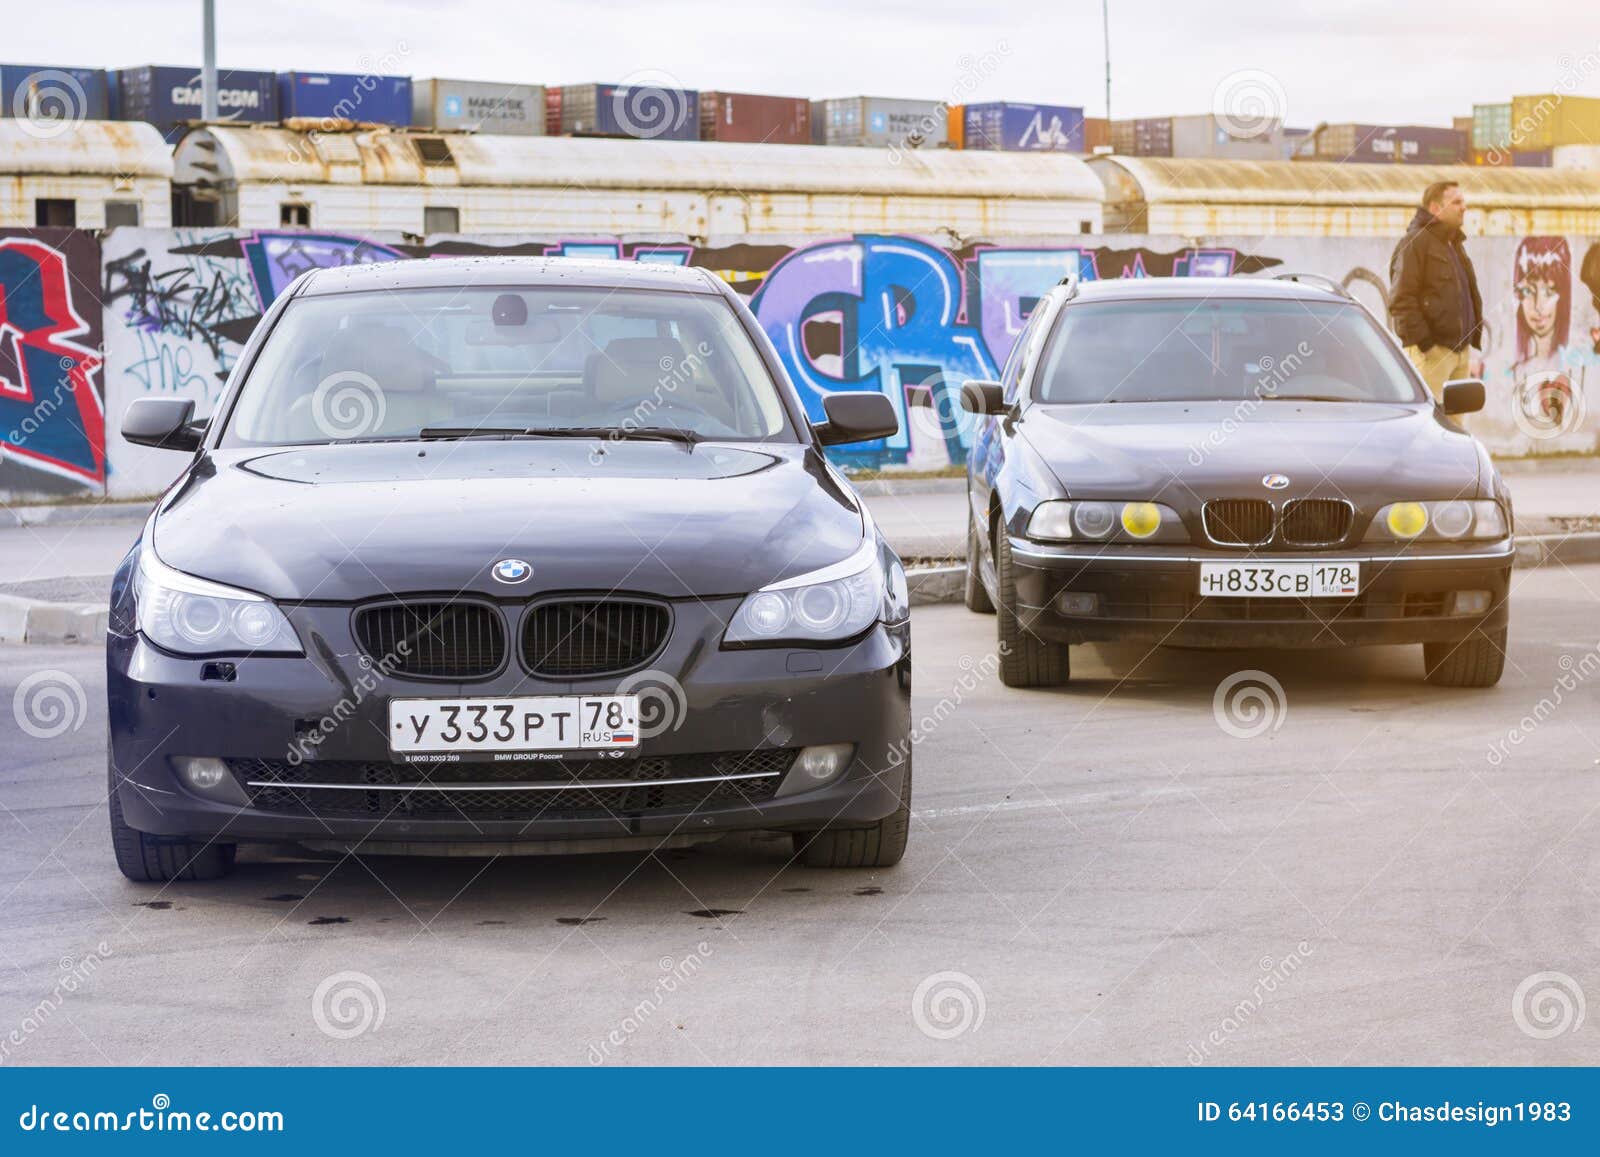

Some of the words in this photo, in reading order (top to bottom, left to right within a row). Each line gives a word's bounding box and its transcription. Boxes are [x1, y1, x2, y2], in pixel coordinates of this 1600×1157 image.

[217, 88, 259, 108] CGM
[1315, 567, 1351, 586] 178
[585, 701, 624, 731] 78
[583, 731, 611, 742] RUS
[513, 753, 538, 761] GROUP
